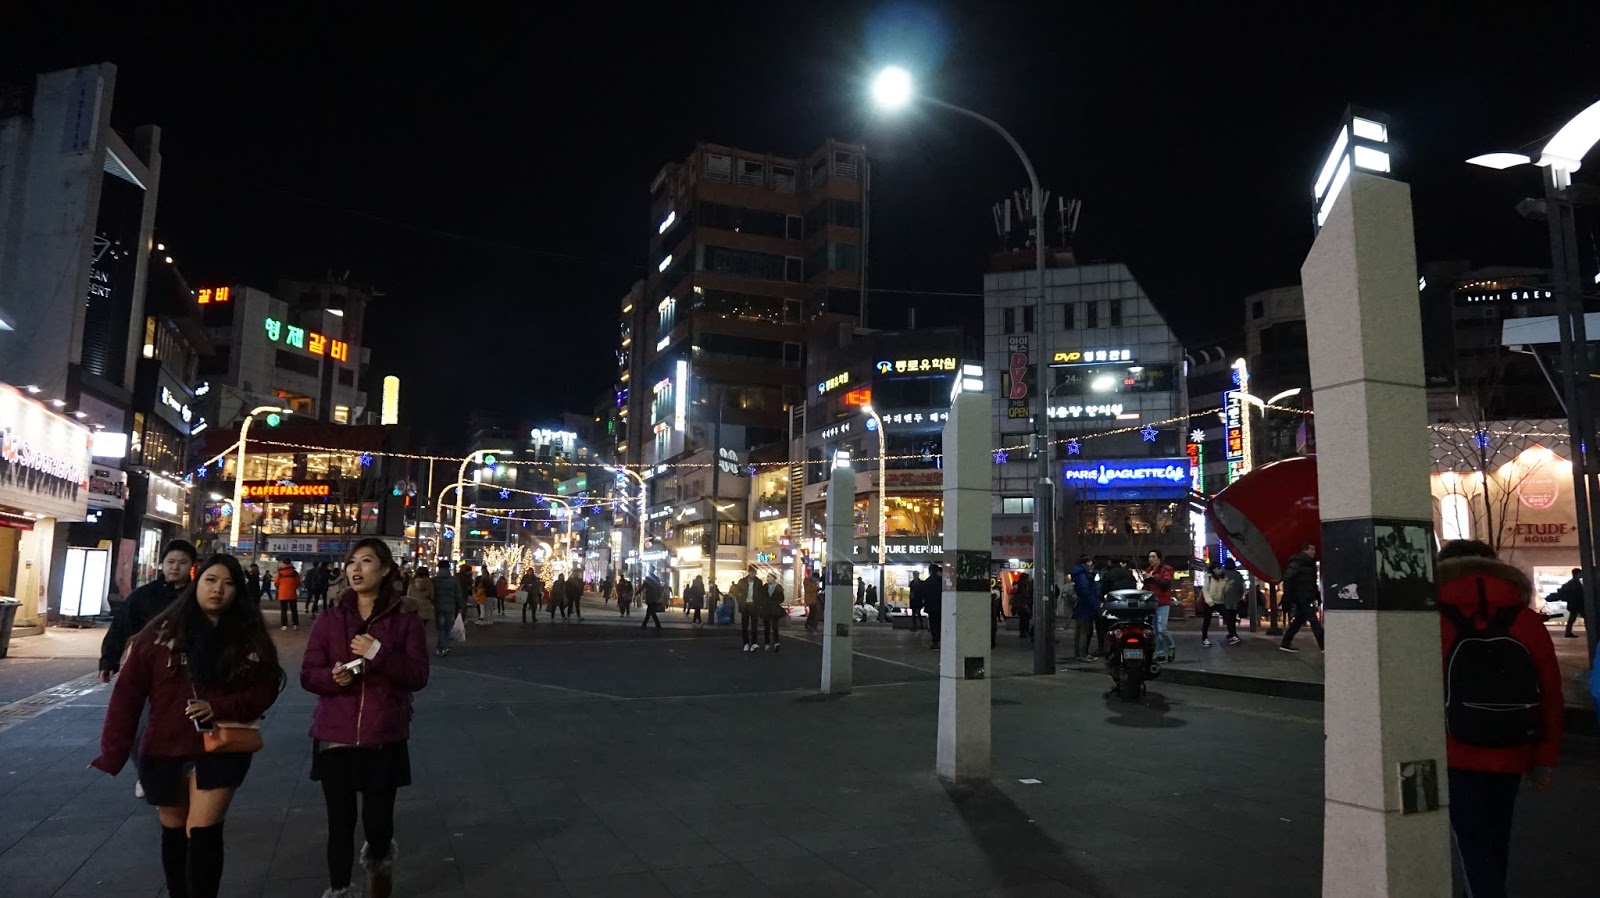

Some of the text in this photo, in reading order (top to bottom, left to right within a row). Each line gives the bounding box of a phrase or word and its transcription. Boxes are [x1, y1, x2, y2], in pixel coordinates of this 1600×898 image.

[198, 287, 229, 303] 갈비
[1054, 351, 1081, 362] DVD
[1009, 353, 1028, 399] DVD
[1009, 407, 1029, 418] OPEN
[1065, 469, 1099, 480] PARIS
[1105, 468, 1166, 480] BAGUETTE
[280, 484, 330, 496] PASCUCCI
[1516, 523, 1568, 535] ETUDE
[1524, 535, 1562, 543] HOUSE
[871, 545, 944, 554] NTURE REPUBL
